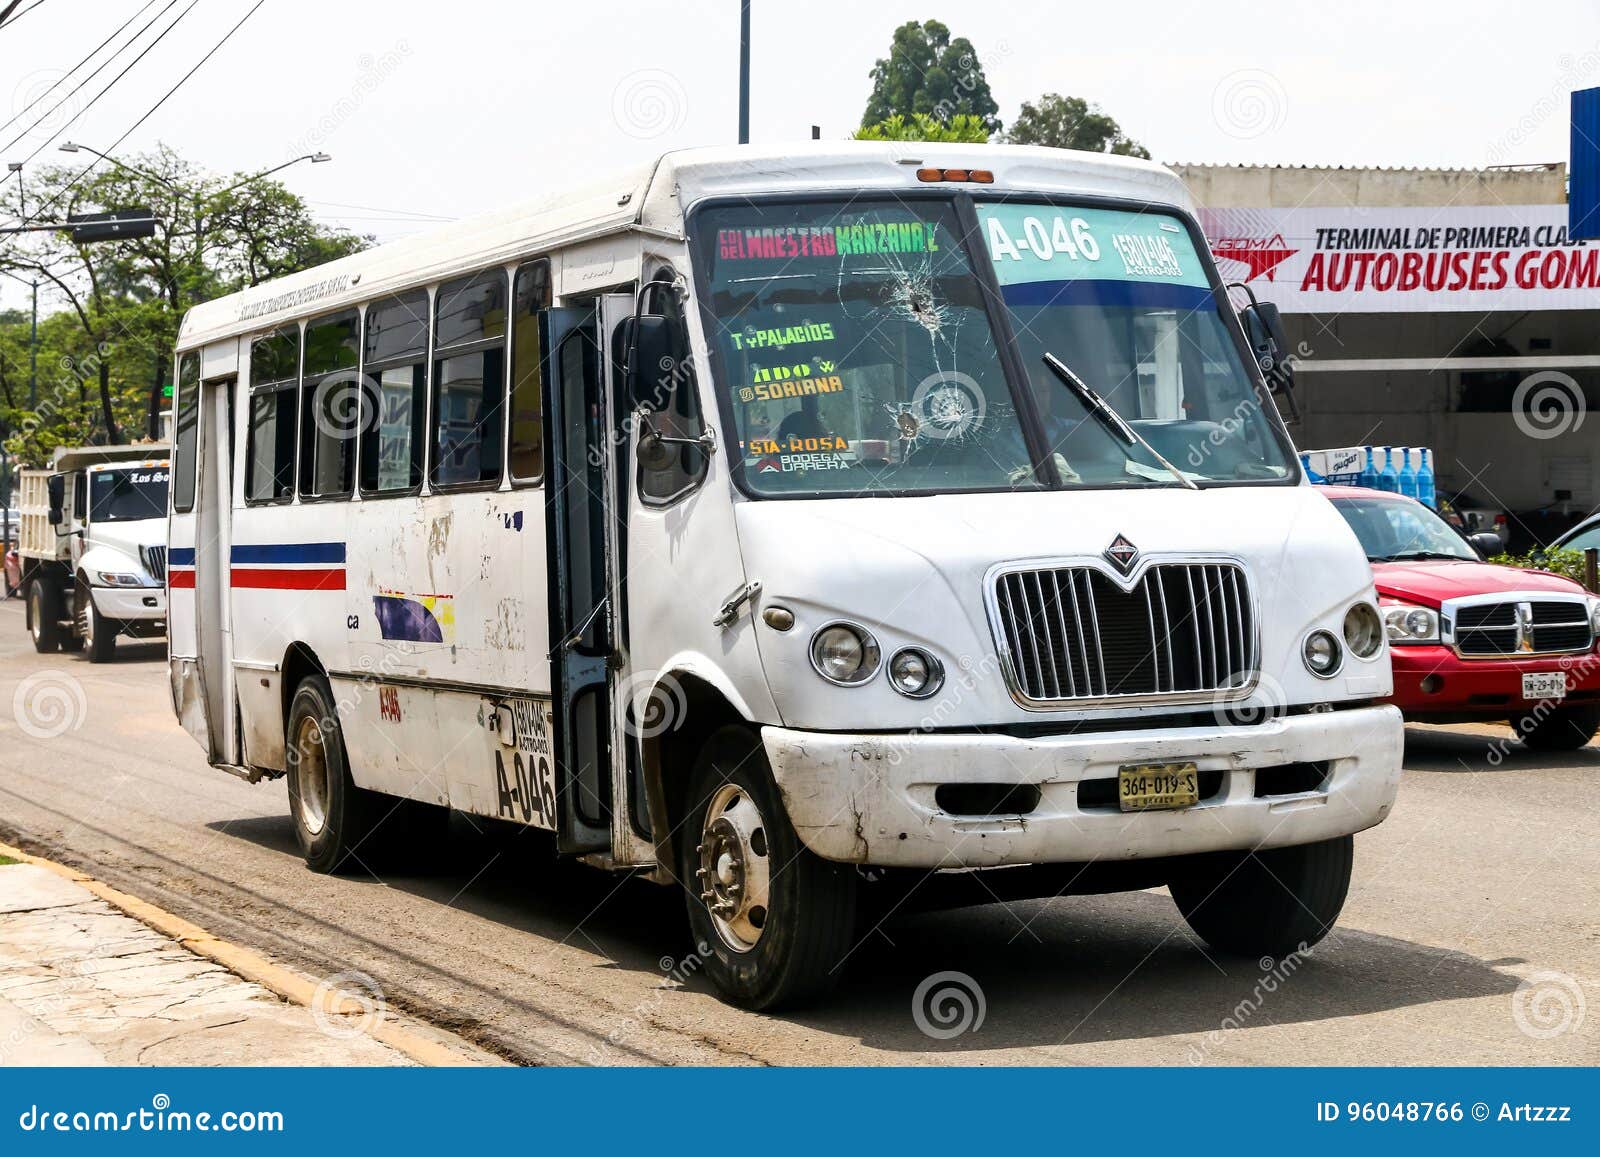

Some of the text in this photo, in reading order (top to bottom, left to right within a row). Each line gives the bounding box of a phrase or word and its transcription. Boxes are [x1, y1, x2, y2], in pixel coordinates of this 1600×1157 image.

[745, 227, 836, 258] MAESTRO
[987, 217, 1100, 261] A-046
[1315, 225, 1587, 250] TERMINAL DE PRIMERA CLA
[1300, 249, 1600, 292] AUTOBUSES GOM
[756, 323, 834, 347] PALACIOS
[755, 376, 844, 400] SORIANA
[790, 437, 847, 452] ROSA
[781, 453, 841, 464] BODEGA
[347, 615, 359, 629] ca
[379, 686, 401, 722] A-046
[496, 750, 556, 830] A-046
